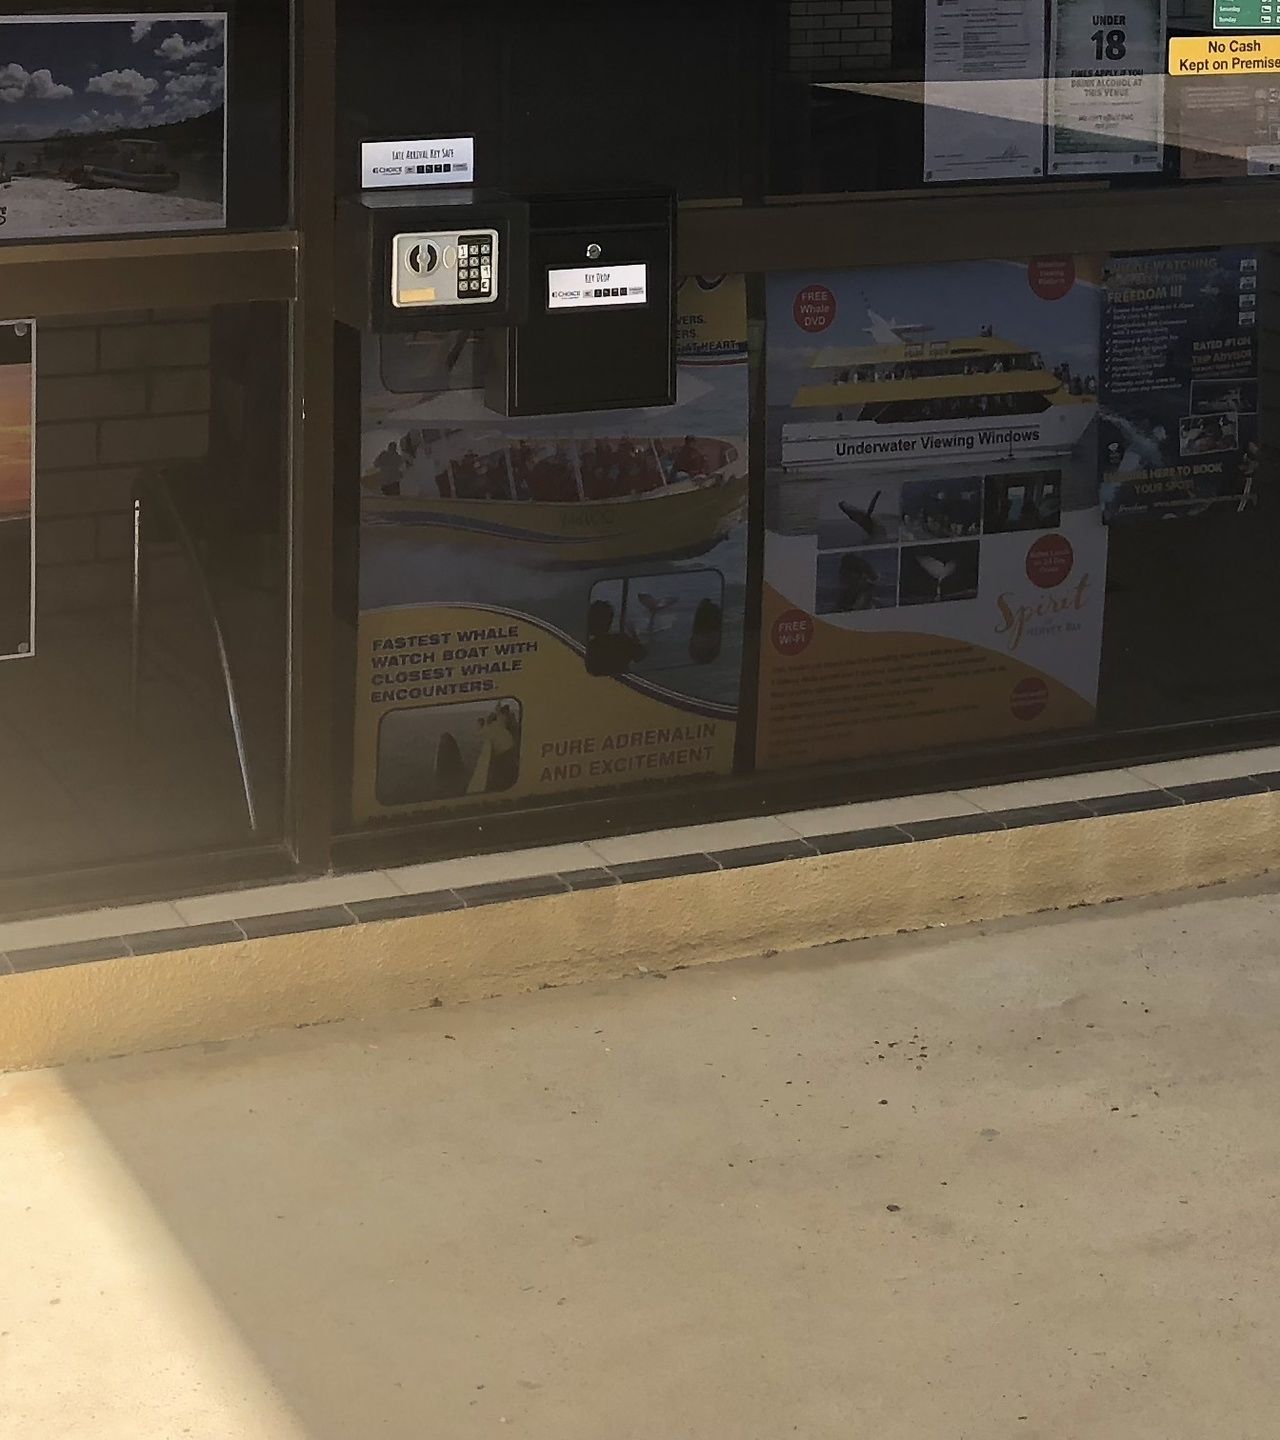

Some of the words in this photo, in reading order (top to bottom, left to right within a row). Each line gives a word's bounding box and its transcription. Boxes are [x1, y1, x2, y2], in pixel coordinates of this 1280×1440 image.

[1092, 15, 1126, 26] UNDER
[1090, 29, 1126, 61] 18
[1208, 41, 1226, 53] No
[1229, 40, 1261, 53] Cash
[1179, 58, 1209, 73] Kept
[1212, 60, 1228, 70] on
[801, 291, 828, 302] FREE
[1106, 286, 1167, 304] FREEDOM
[800, 304, 830, 315] Whale
[804, 316, 826, 327] DVD
[836, 437, 917, 457] Underwater
[920, 433, 975, 450] Viewing
[978, 429, 1040, 446] Windows
[1192, 463, 1223, 475] BOOK
[1134, 482, 1163, 495] YOUR
[778, 620, 808, 632] FREE
[372, 632, 452, 652] FASTEST
[457, 626, 519, 643] WHALE
[372, 651, 435, 669] WATCH
[442, 646, 490, 662] BOAT
[494, 641, 538, 656] WITH
[371, 666, 455, 686] CLOSEST
[461, 659, 523, 676] WHALE
[370, 679, 499, 703] ENCOUNTERS.
[541, 737, 596, 758] PURE
[602, 723, 717, 752] ADRENALIN
[539, 763, 582, 783] AND
[589, 746, 714, 776] EXCITEMENT
